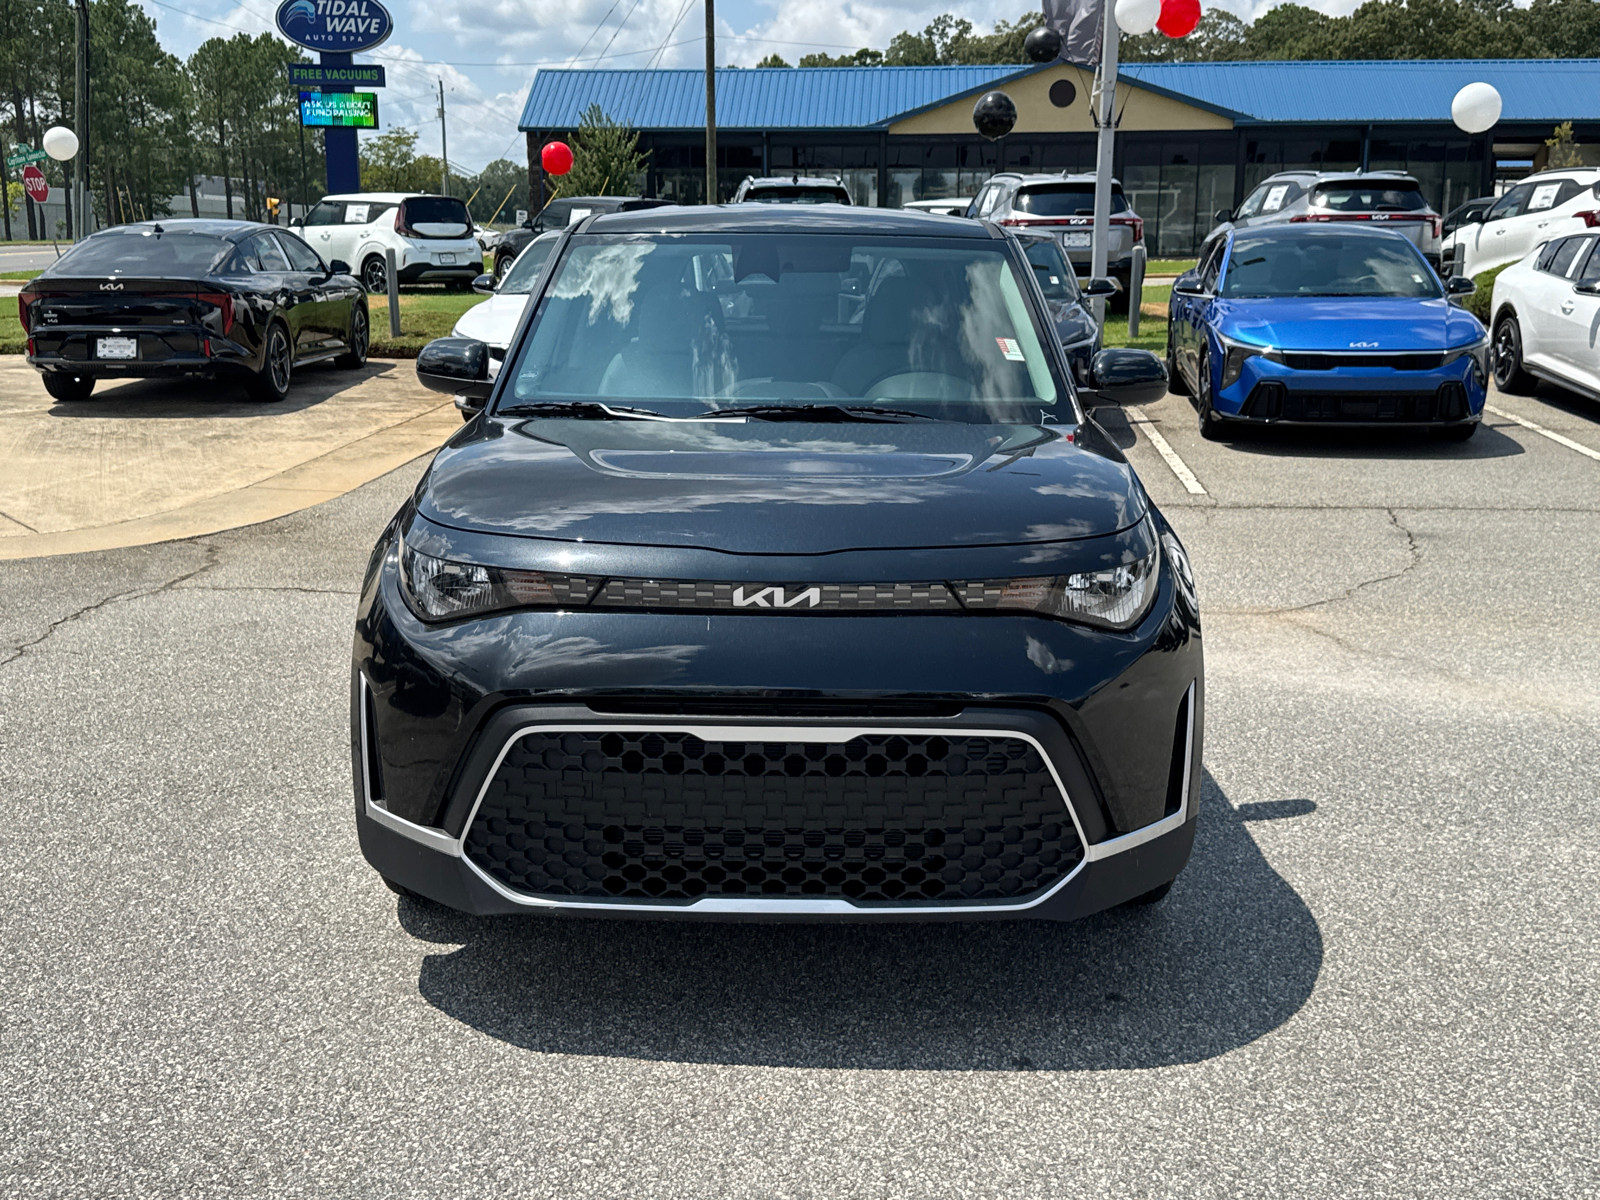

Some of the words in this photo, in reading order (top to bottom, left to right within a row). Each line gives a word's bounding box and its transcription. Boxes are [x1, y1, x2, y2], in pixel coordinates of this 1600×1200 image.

[317, 0, 369, 16] TIDAL
[326, 17, 380, 33] WAVE
[293, 69, 322, 79] FREE
[325, 69, 378, 80] VACUUMS
[304, 101, 322, 109] ASK
[325, 101, 337, 109] US
[339, 101, 371, 109] ABOUT
[306, 109, 371, 117] FUNDRAISING
[25, 177, 46, 191] STOP
[733, 586, 820, 608] KIA
